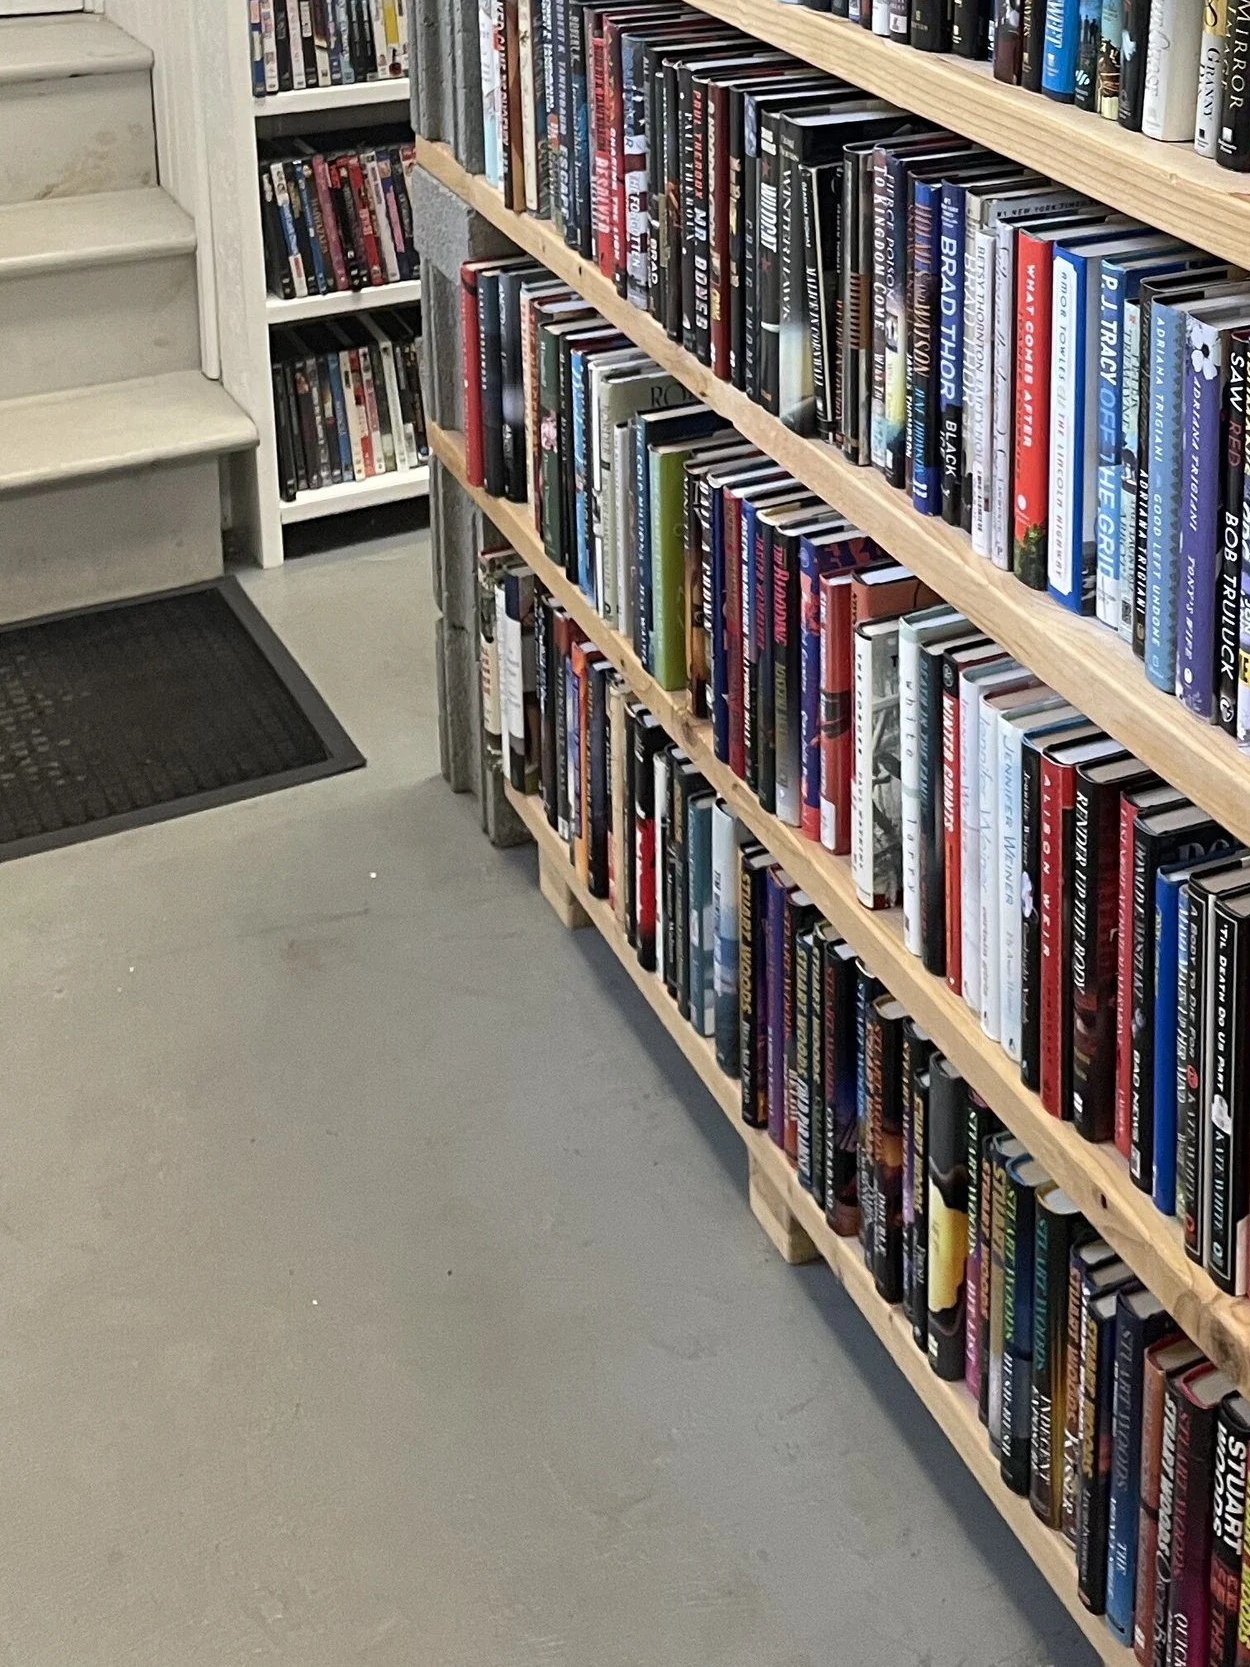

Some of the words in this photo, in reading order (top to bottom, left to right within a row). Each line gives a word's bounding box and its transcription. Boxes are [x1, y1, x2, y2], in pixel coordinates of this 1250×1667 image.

[941, 236, 959, 313] BRAD
[1024, 263, 1038, 313] WHAT
[940, 321, 960, 407] THOR
[1024, 318, 1037, 380] COMES
[1229, 352, 1246, 409] SAW
[1022, 384, 1035, 449] AFTER
[1226, 420, 1243, 468] RED
[1224, 511, 1241, 562] BOB
[1217, 572, 1240, 683] TRULUCK
[1041, 772, 1052, 875] ALISON
[1040, 892, 1051, 959] WEIR
